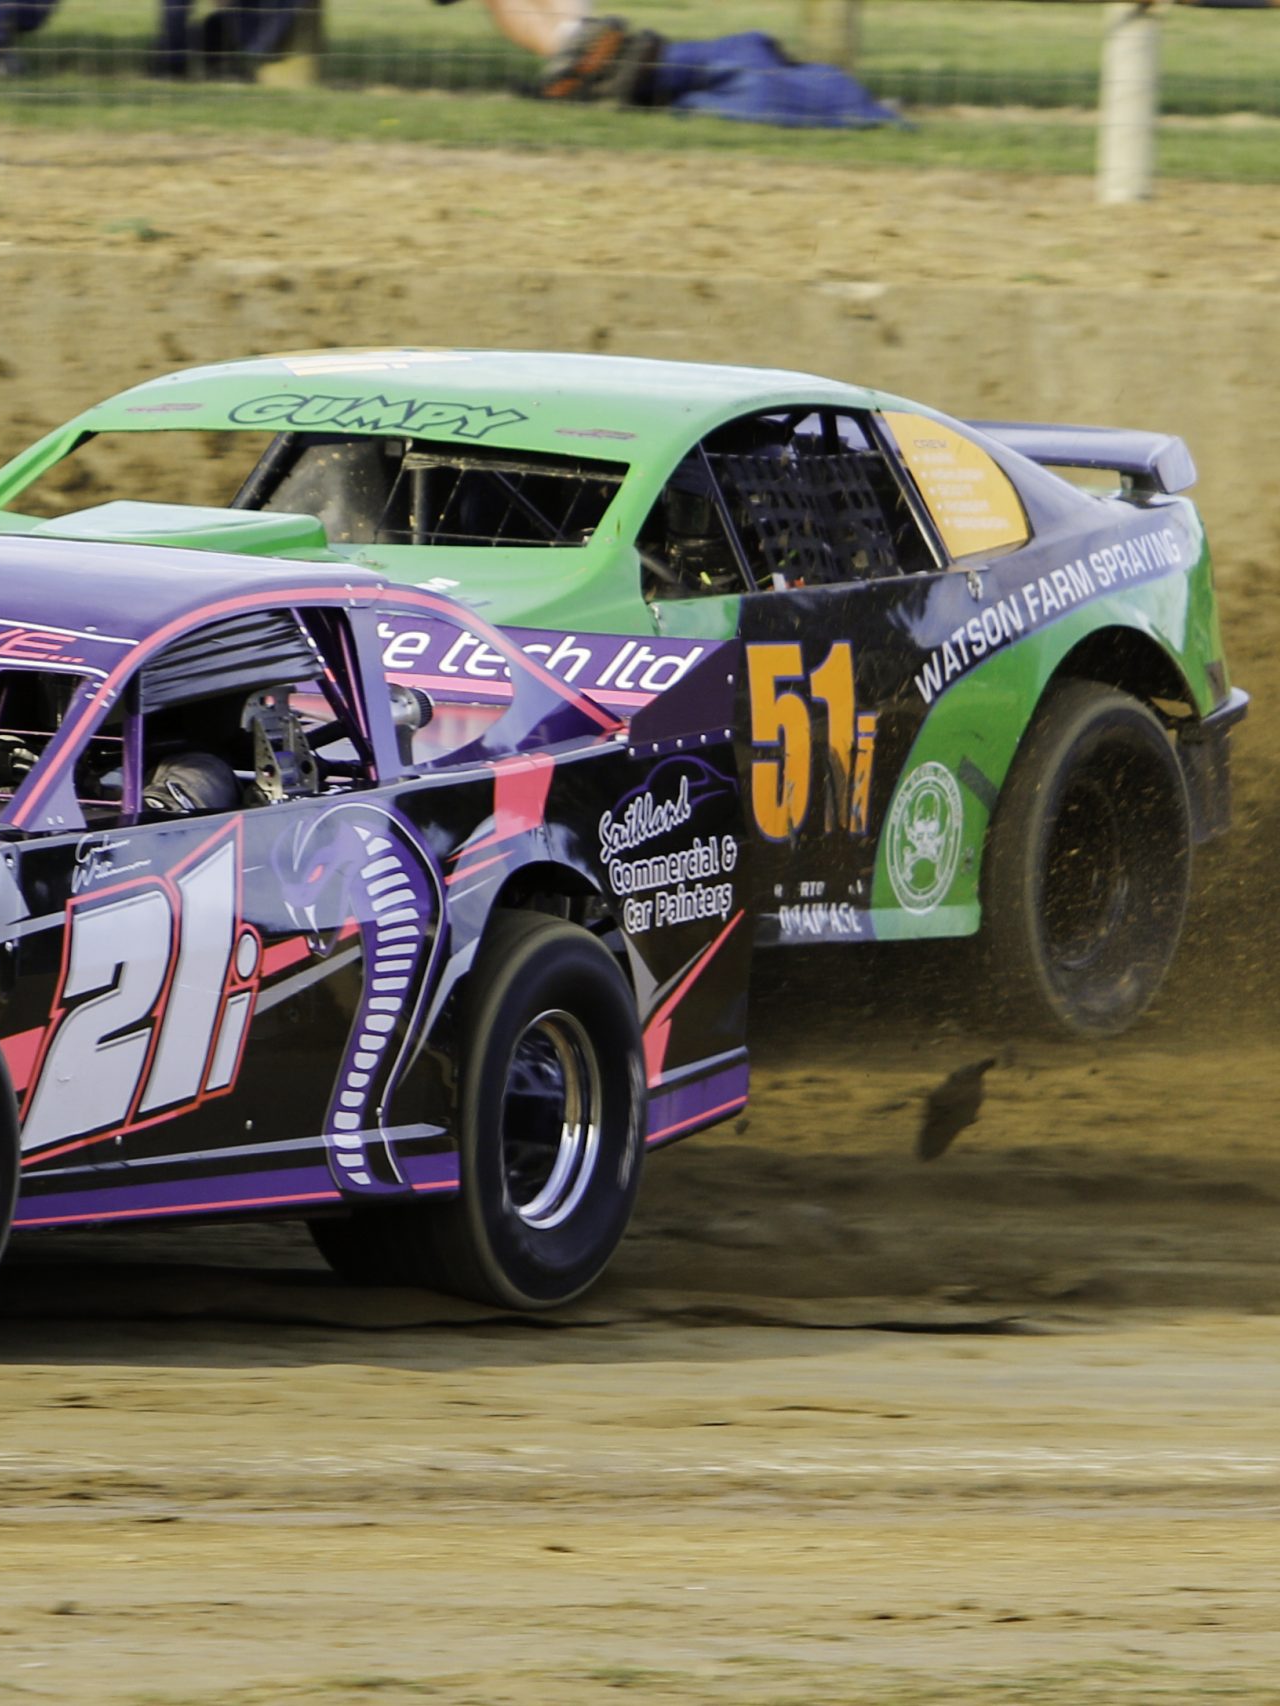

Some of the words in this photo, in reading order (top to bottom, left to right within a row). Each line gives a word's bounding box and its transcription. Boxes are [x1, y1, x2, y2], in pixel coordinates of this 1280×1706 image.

[228, 393, 530, 439] GUMPY
[914, 594, 1024, 705] WATSON
[1021, 558, 1096, 624] FARM
[1088, 527, 1183, 588] SPRAYING
[595, 640, 705, 690] ltd
[609, 836, 721, 896] Commercial
[721, 834, 738, 872] &
[624, 897, 654, 935] Car
[655, 882, 734, 928] Painters
[19, 822, 262, 1162] 21i
